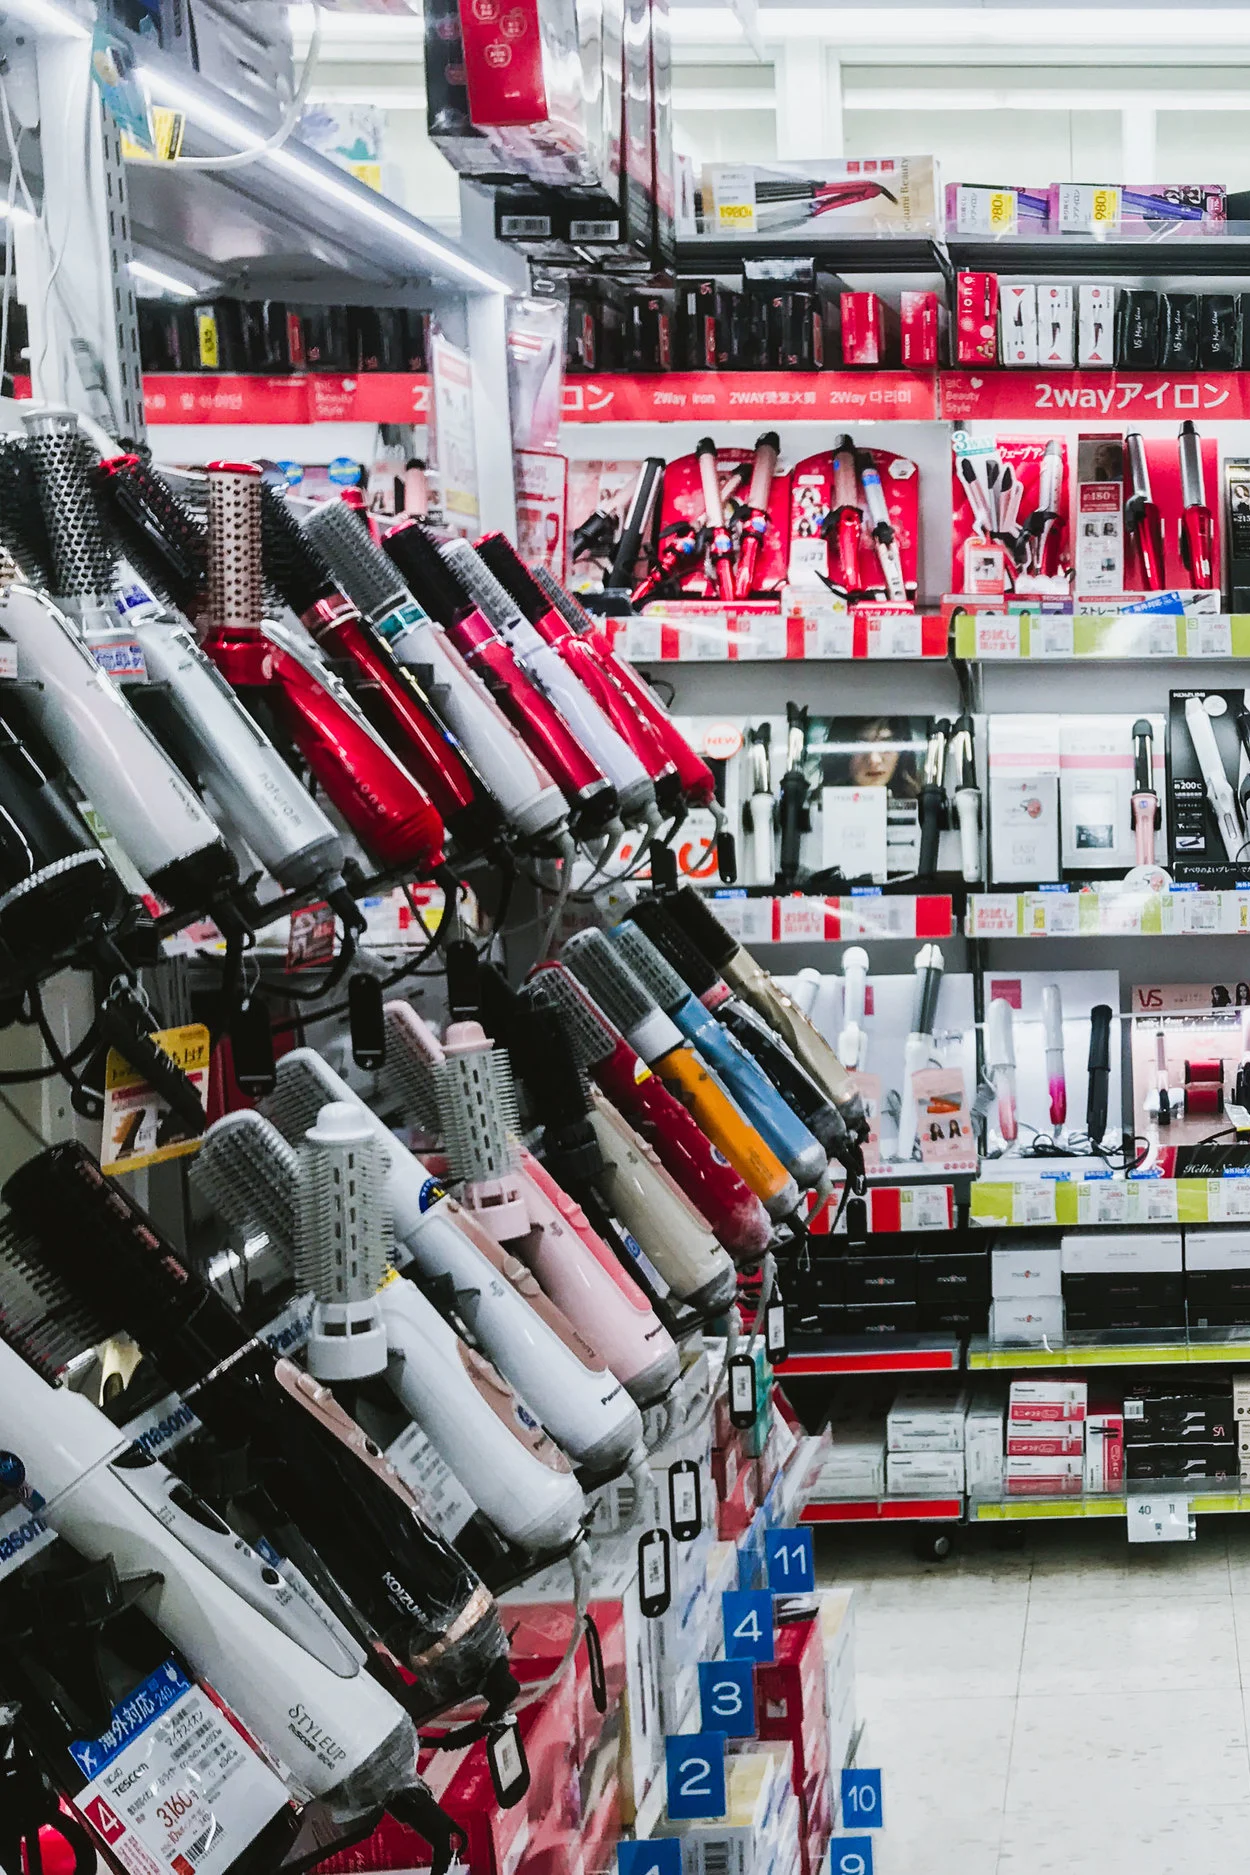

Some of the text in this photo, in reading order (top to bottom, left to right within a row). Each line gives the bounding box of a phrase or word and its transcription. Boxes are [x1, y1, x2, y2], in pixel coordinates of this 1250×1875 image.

[945, 390, 981, 403] Beauty
[945, 402, 972, 415] Style
[1034, 381, 1231, 414] 2wayアイロン
[1138, 1505, 1152, 1515] 40
[774, 1545, 807, 1576] 11
[732, 1609, 763, 1644] 4
[711, 1681, 743, 1717] 3
[98, 1689, 156, 1754] 海外対応
[287, 1703, 347, 1763] STYLEUP
[111, 1762, 151, 1798] TESCOM
[679, 1758, 712, 1797] 2
[847, 1784, 876, 1813] 10
[99, 1802, 121, 1834] 4
